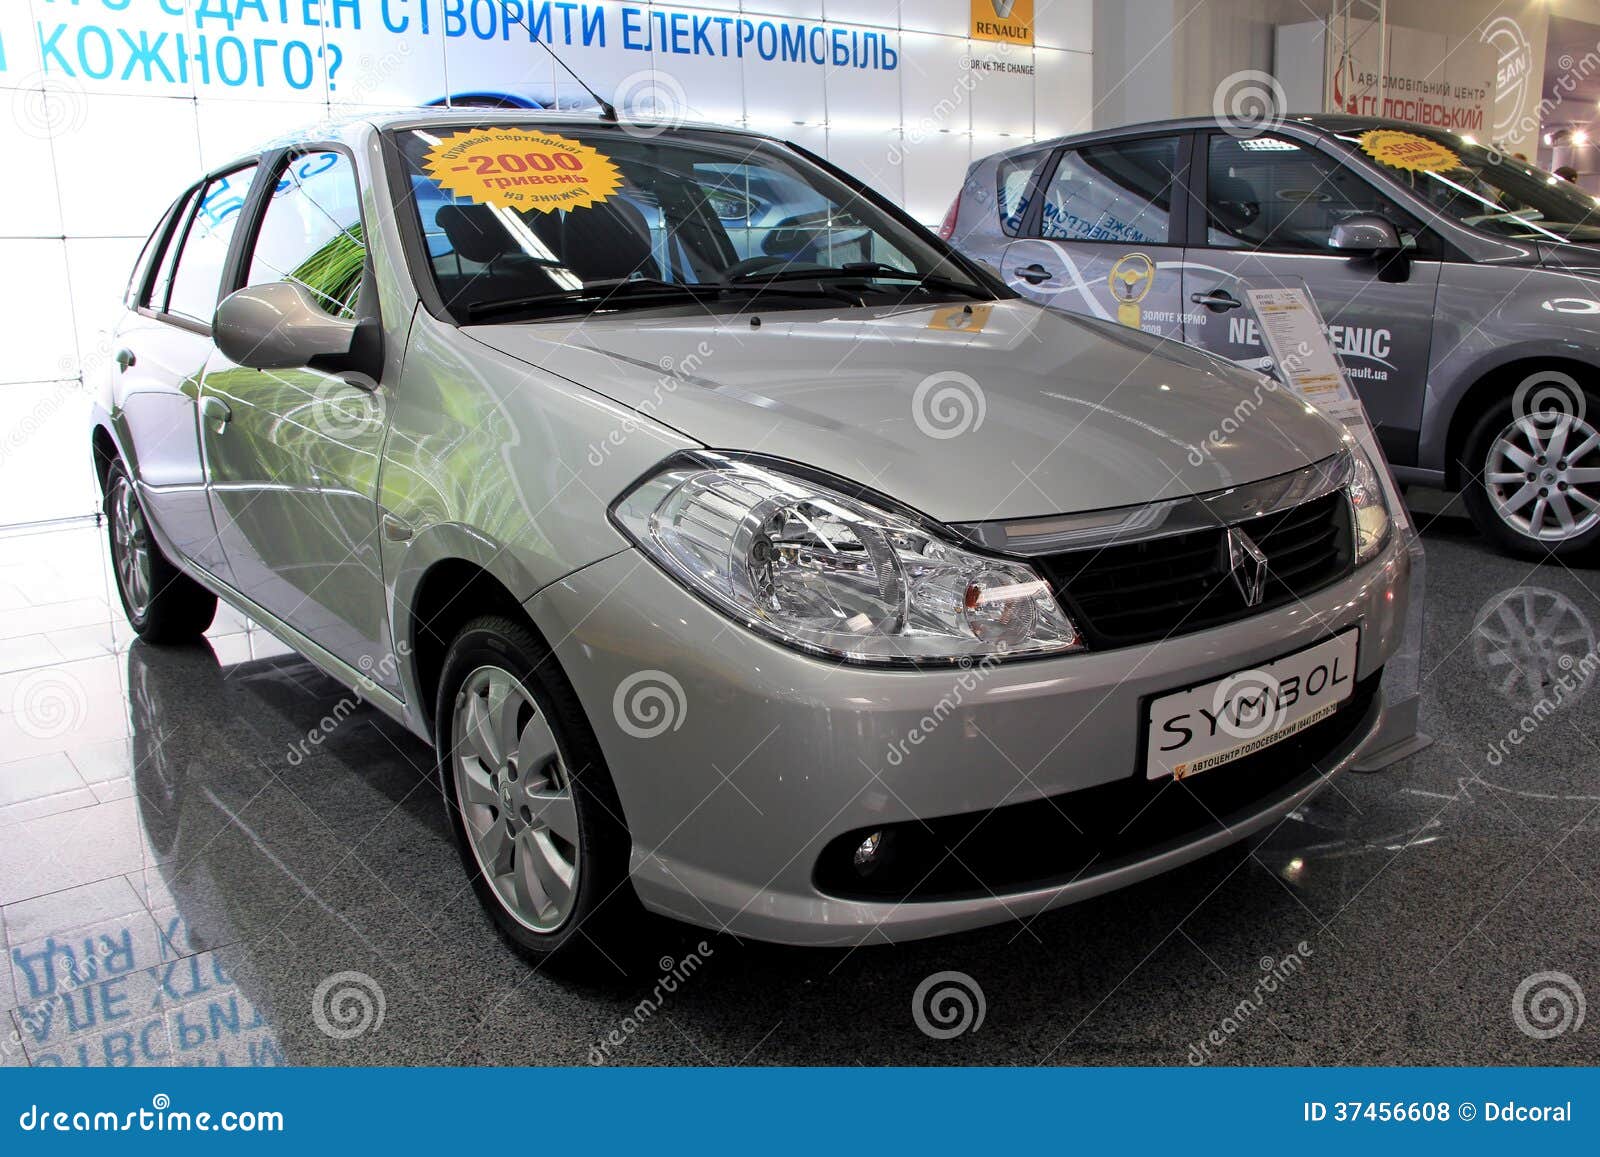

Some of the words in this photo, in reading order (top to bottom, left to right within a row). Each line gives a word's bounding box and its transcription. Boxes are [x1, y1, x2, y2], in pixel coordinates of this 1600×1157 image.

[381, 0, 606, 48] СТВОРИТИ
[622, 7, 899, 71] ЕЛЕКТРОМОБІЛЬ
[976, 22, 1029, 39] RENAULT
[37, 20, 343, 91] КОЖНОГО?
[970, 59, 991, 70] DRIVE
[992, 61, 1006, 72] THE
[1007, 62, 1034, 75] CHANGE
[1454, 87, 1486, 101] ЦЕНТР
[441, 135, 492, 160] Отримай
[496, 134, 585, 155] сертифікат
[451, 152, 583, 175] -2000
[483, 173, 588, 190] гривень
[504, 190, 524, 201] на
[531, 186, 590, 203] знижку
[1143, 310, 1174, 323] ЗОЛОТЕ
[1228, 317, 1261, 346] NE
[1159, 656, 1349, 752] SYMBOL
[1191, 748, 1241, 773] АВТОЦЕНТР
[1240, 721, 1297, 756] ГОЛОСЕЕВСКИЙ
